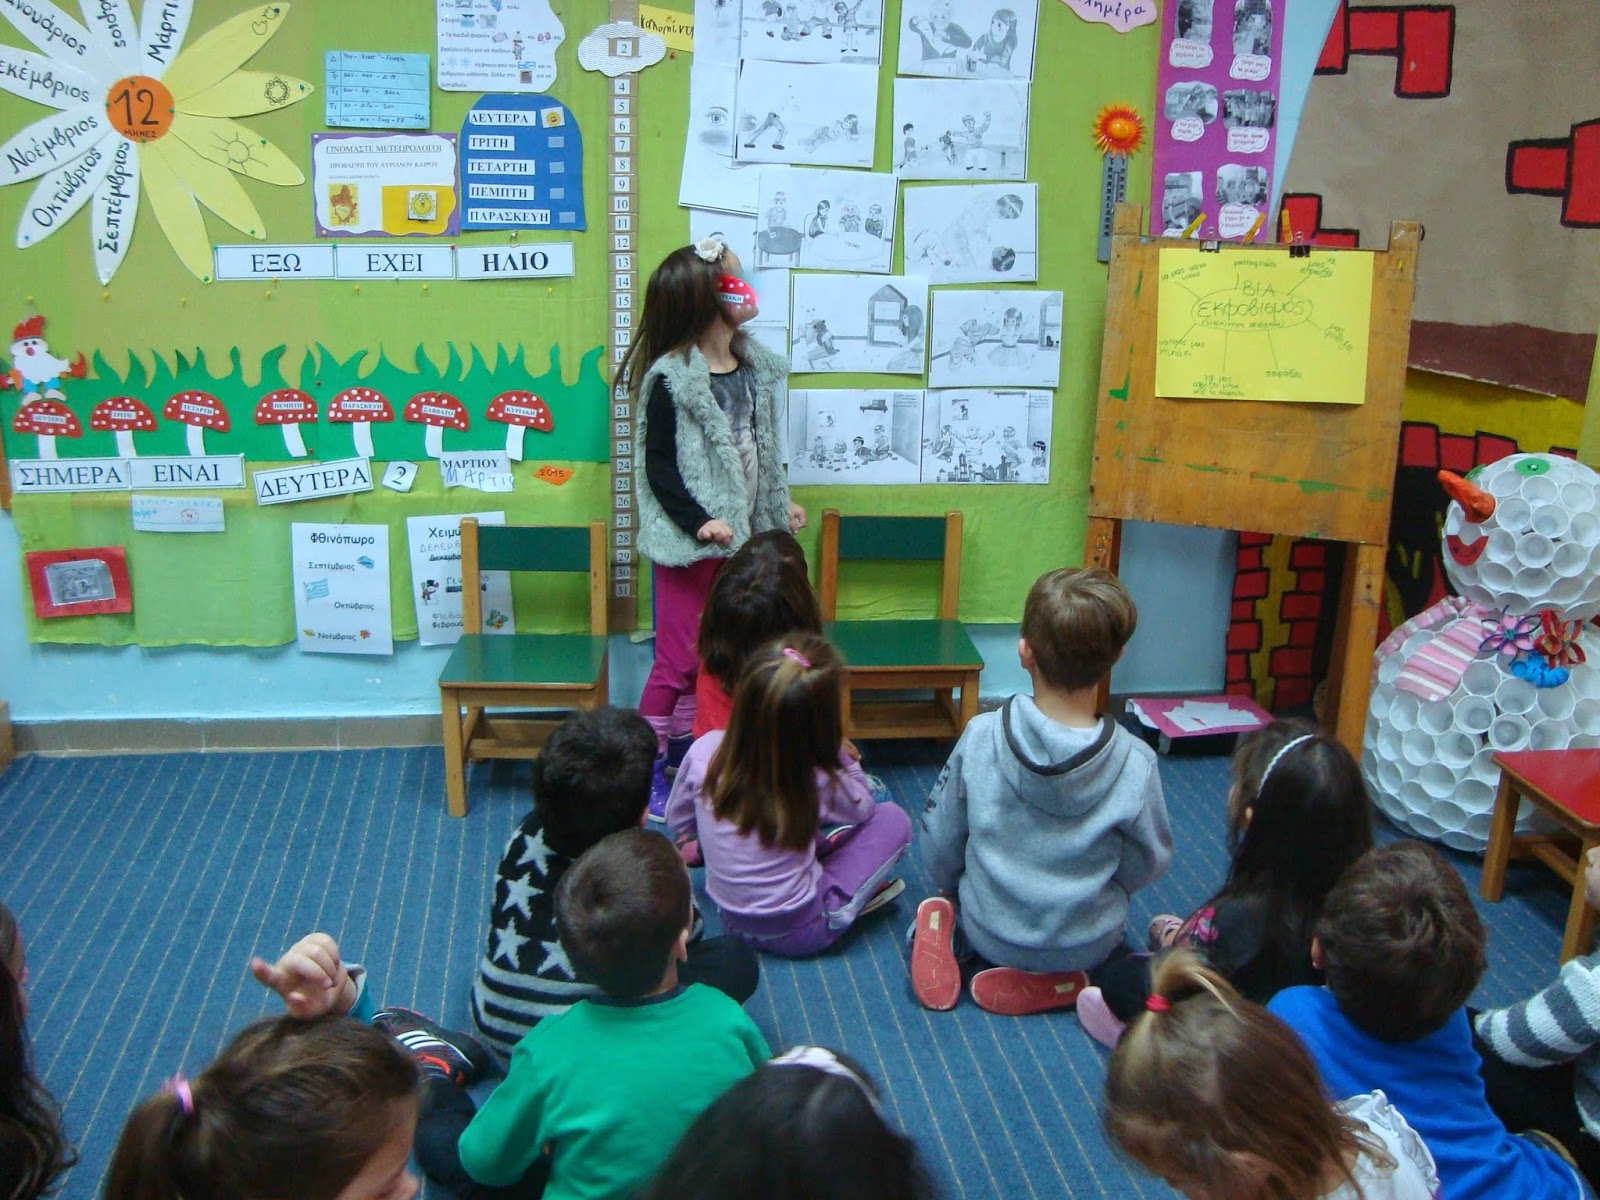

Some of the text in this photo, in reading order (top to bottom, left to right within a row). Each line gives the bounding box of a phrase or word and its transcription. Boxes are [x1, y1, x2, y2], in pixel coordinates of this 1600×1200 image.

[621, 44, 627, 53] 2
[619, 82, 625, 92] 4
[114, 89, 160, 126] 12
[620, 102, 625, 111] 5
[471, 113, 528, 124] ΔΕΥΤΕΡΑ
[620, 121, 625, 130] 6
[6, 116, 98, 174] Νοέμβριος
[471, 138, 508, 148] ΤΡΙΤΗ
[620, 140, 625, 149] 7
[469, 162, 527, 172] ΤΕΤΑΡΤΗ
[620, 160, 625, 170] 8
[32, 148, 103, 228] Οκτώβριος
[619, 180, 625, 189] 9
[98, 141, 131, 253] Σεπτέμβριος
[471, 187, 527, 198] ΠΕΜΠΤΗ
[617, 200, 628, 209] 10
[470, 211, 548, 222] ΠΑΡΑΣΚΕΥΗ
[618, 219, 628, 228] 11
[617, 238, 628, 247] 12
[252, 252, 549, 272] ΕΞΩ ΕΧΕΙ ΗΛΙΟ
[618, 258, 628, 267] 13
[618, 278, 629, 287] 14
[1242, 280, 1274, 297] ΒΙΑ
[618, 297, 629, 306] 15
[618, 316, 629, 324] 16
[618, 333, 628, 342] 17
[617, 388, 628, 396] 20
[184, 404, 212, 414] ΤΕΤΑΡΤΗ
[424, 406, 454, 416] ΣΑΒΒΑΤΟ
[506, 406, 535, 416] ΚΥΡΙΑΚΗ
[617, 407, 627, 416] 21
[617, 426, 628, 434] 22
[618, 444, 629, 452] 23
[443, 459, 499, 468] ΜΑΡΤΙΟΥ
[618, 462, 629, 470] 24
[392, 466, 404, 485] 2
[20, 464, 368, 498] ΣΗΜΕΡΑ ΕΙΝΑΙ ΔΕΥΤΕΡΑ
[617, 480, 628, 489] 25
[617, 498, 629, 506] 26
[618, 516, 629, 525] 27
[311, 533, 374, 546] Φθινόπωρο
[618, 534, 629, 543] 28
[618, 552, 629, 560] 29
[309, 562, 355, 571] Σεπτέμβριος
[618, 568, 629, 577] 30
[618, 587, 628, 595] 31
[334, 602, 374, 610] Οκτώβριος
[318, 633, 356, 641] Νοέμβριος
